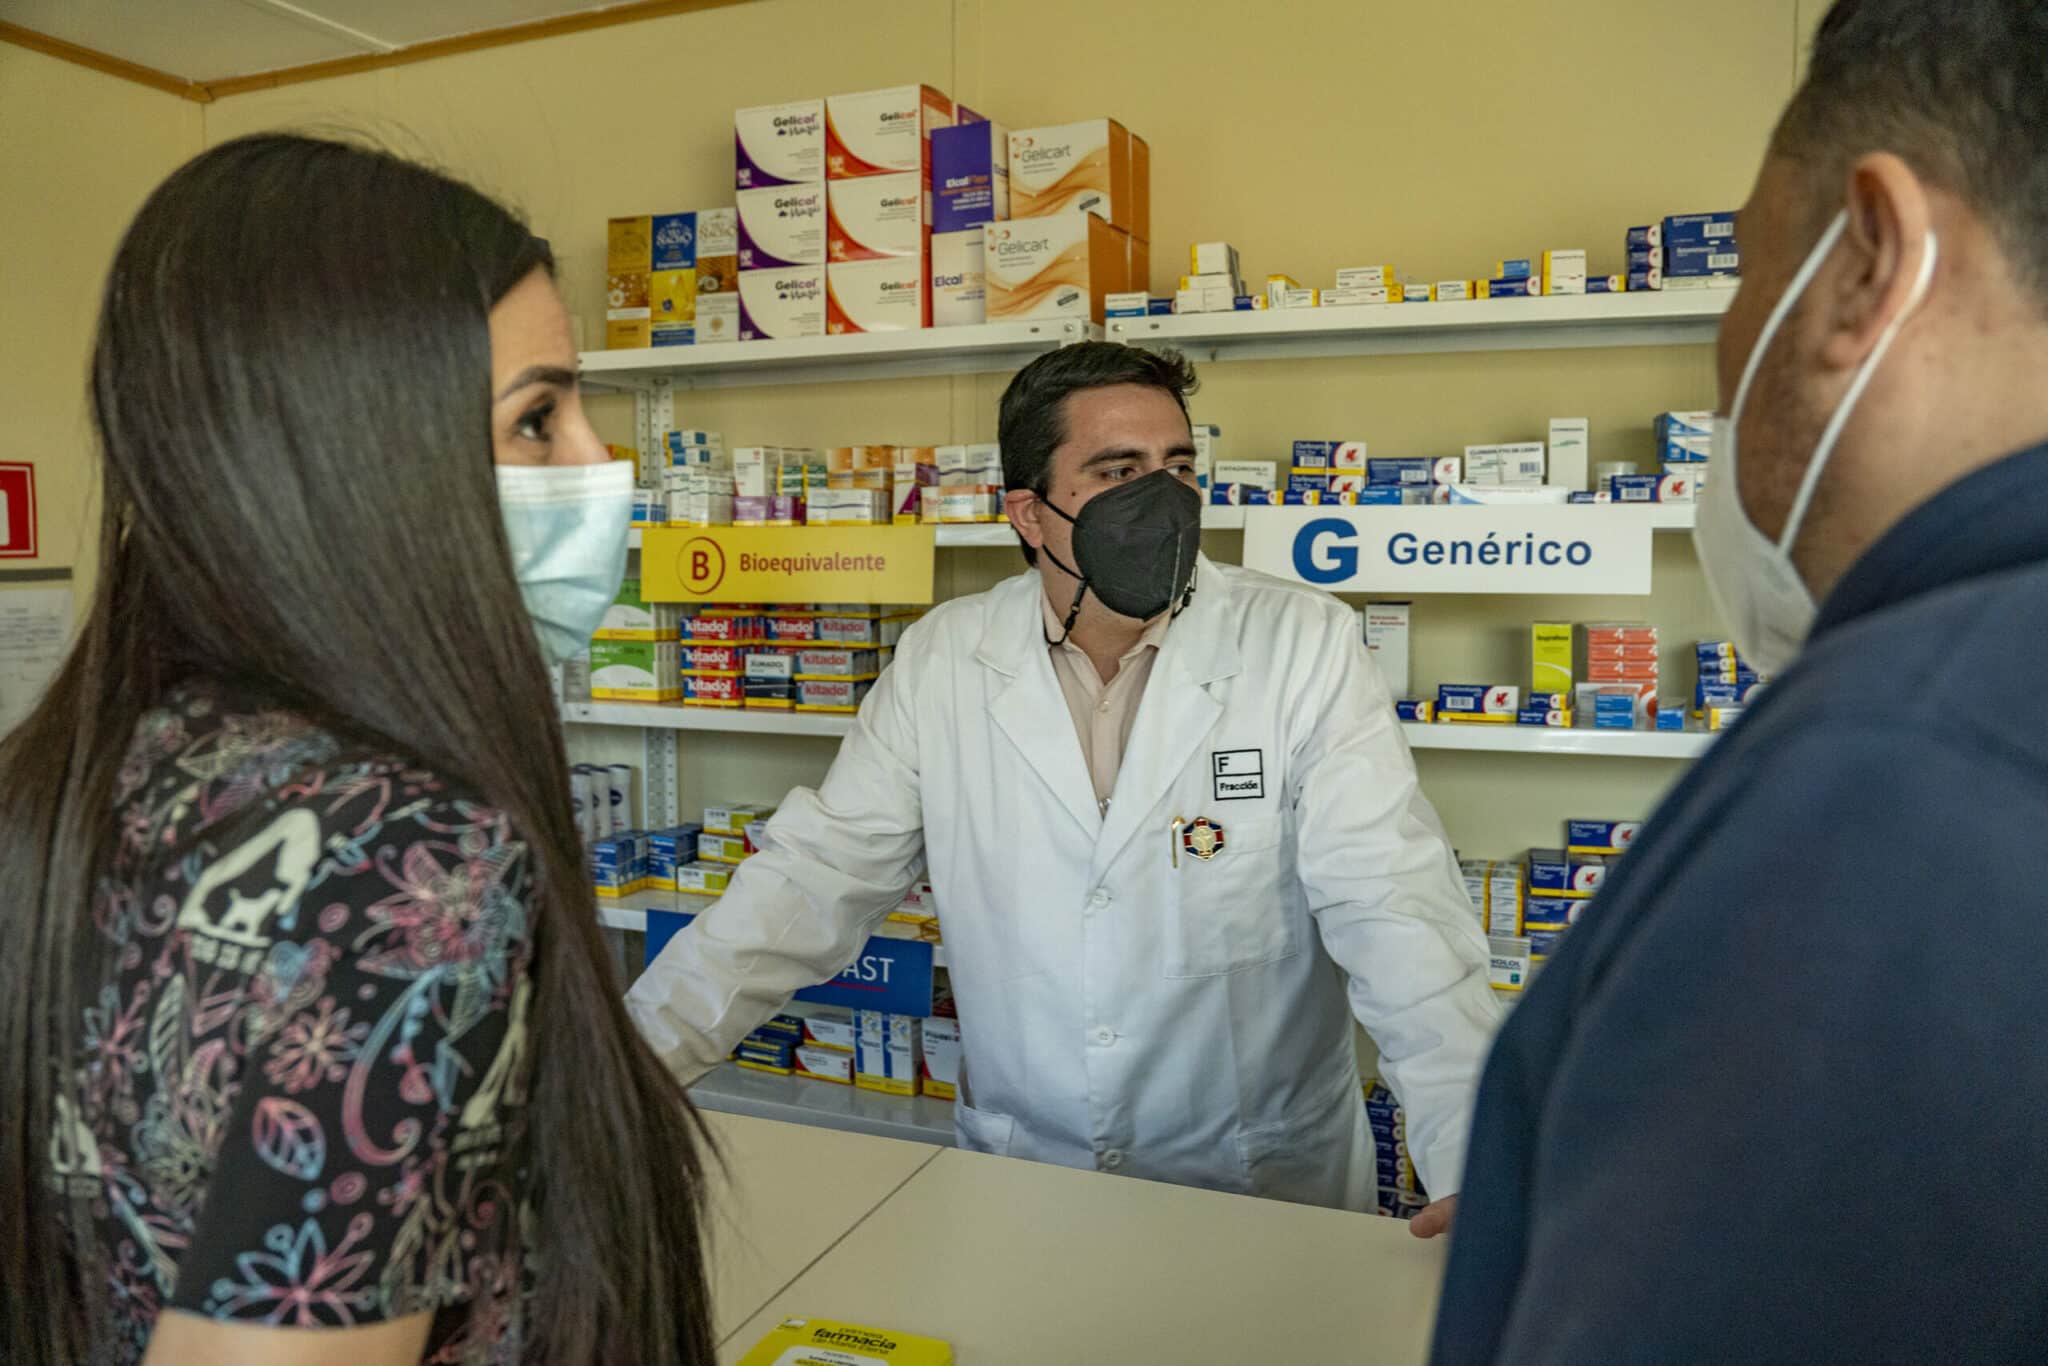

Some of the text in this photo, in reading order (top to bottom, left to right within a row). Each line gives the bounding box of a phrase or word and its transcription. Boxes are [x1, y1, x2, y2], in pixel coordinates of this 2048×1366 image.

[1022, 145, 1071, 162] Gelicart
[998, 238, 1049, 255] Gelicart
[1292, 518, 1592, 584] G Genérico
[691, 551, 886, 581] B Bioequivalente
[684, 618, 728, 632] kitadol
[769, 619, 813, 633] kitadol
[823, 620, 865, 632] kitadol
[684, 649, 728, 663] kitadol
[803, 653, 848, 666] kitadol
[687, 677, 732, 692] kitadol
[805, 683, 848, 696] kitadol
[1217, 756, 1230, 773] F
[1220, 780, 1258, 792] Fracción
[842, 955, 895, 984] AST
[813, 1327, 897, 1350] farmacia
